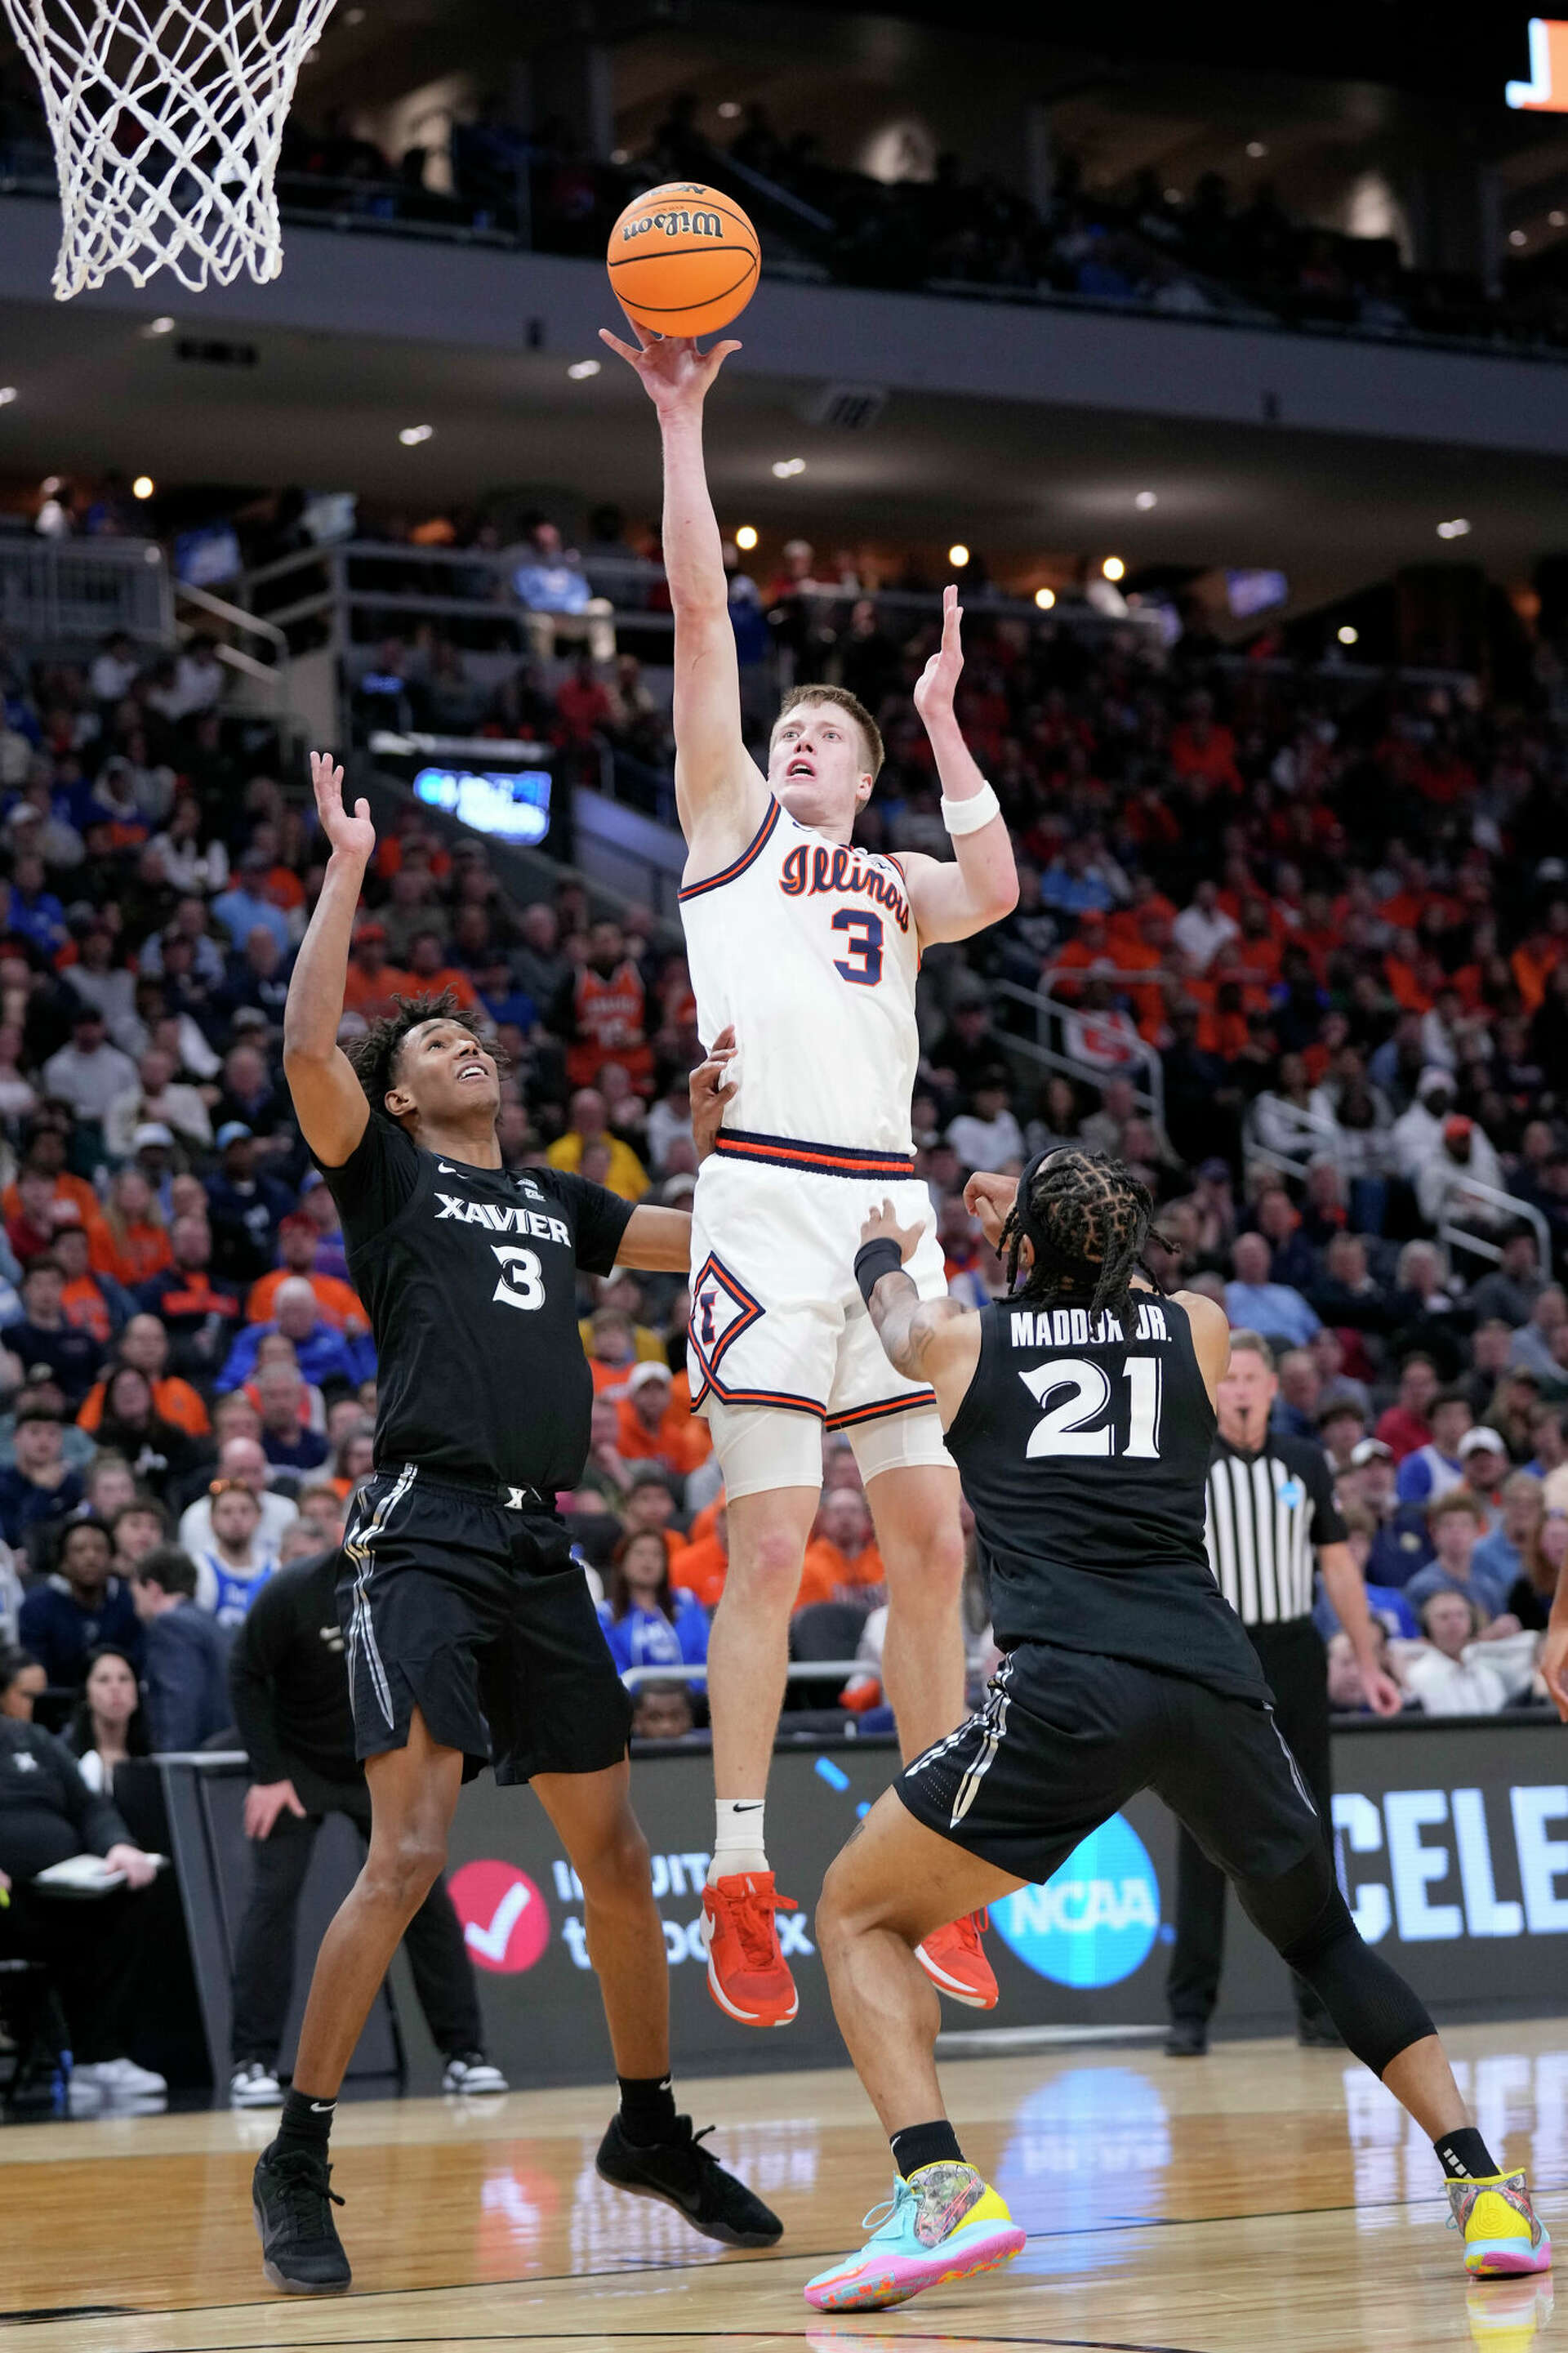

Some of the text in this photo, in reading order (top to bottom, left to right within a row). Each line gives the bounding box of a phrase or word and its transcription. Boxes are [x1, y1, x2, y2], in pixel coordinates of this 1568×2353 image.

[623, 211, 724, 241] Wilson
[831, 907, 884, 987] 3
[434, 1192, 572, 1248] XAVIER
[490, 1244, 546, 1311] 3
[1135, 1304, 1173, 1343] JR.
[1018, 1357, 1163, 1459] 21
[1010, 1878, 1159, 1936] NCAA
